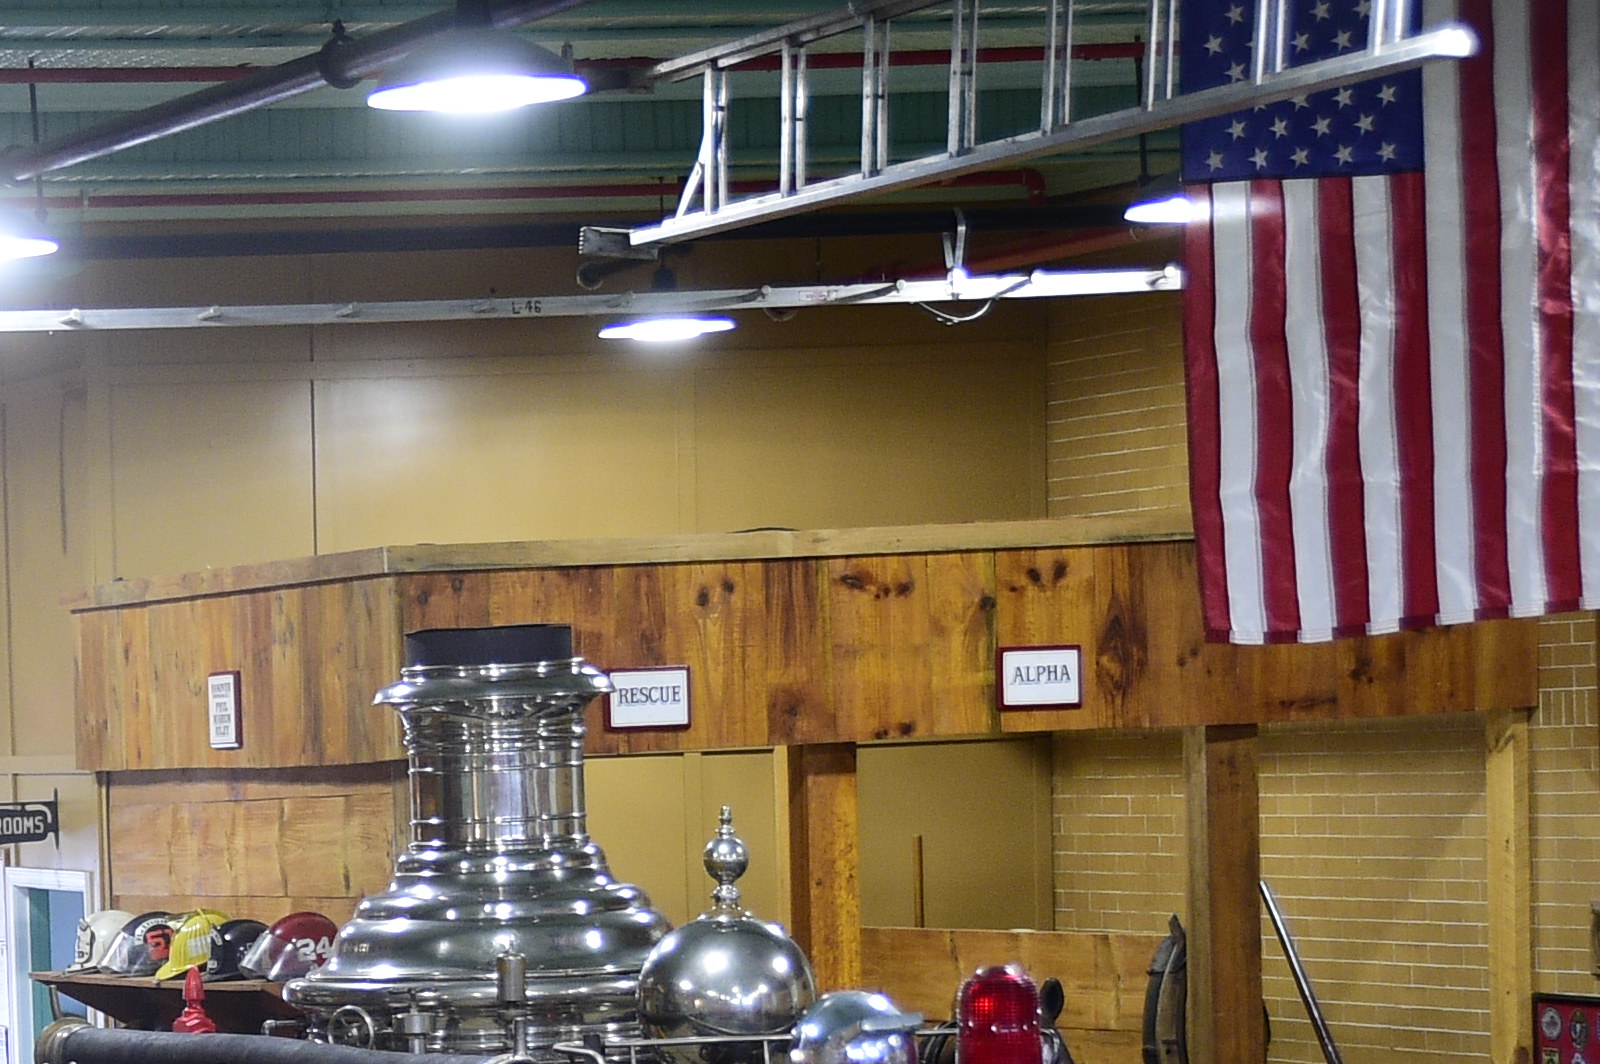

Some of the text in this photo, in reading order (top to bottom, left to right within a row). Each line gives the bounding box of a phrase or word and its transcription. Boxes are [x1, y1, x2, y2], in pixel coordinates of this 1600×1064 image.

[511, 300, 542, 314] L-46
[1012, 664, 1072, 683] ALPHA
[617, 684, 682, 704] RESCUE
[296, 936, 334, 961] 24
